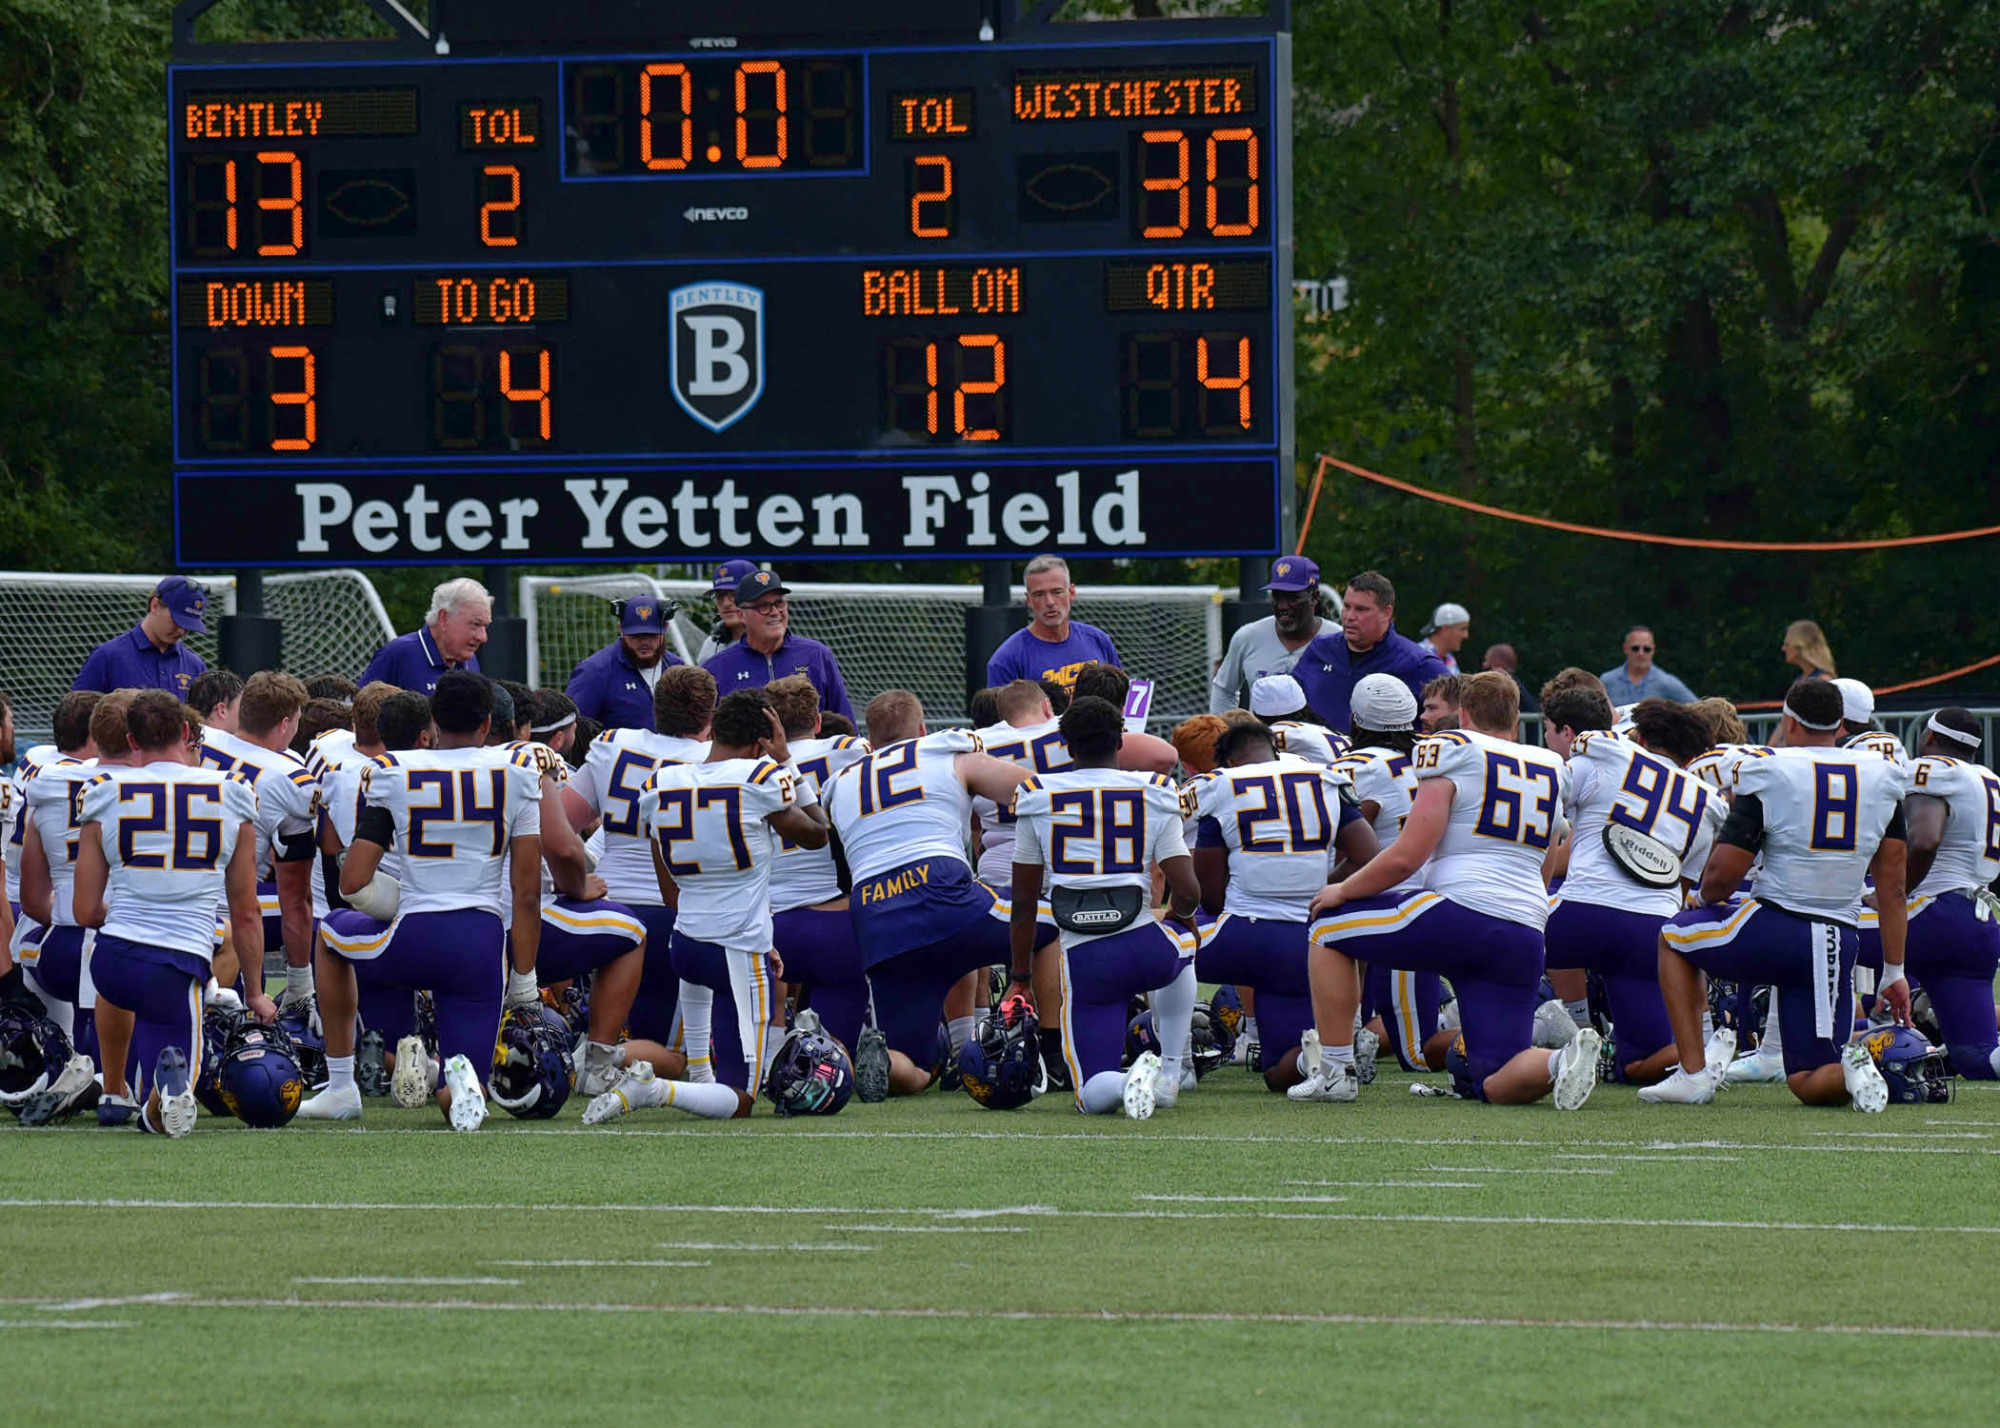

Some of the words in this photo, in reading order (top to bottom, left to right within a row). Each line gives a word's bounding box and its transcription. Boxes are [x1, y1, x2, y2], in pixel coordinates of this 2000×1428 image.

[186, 102, 323, 138] BENTLEY
[469, 109, 535, 144] TOL
[901, 98, 968, 134] TOL
[1014, 78, 1242, 119] WESTCHESTER
[225, 151, 303, 256] 13
[481, 165, 521, 246] 2
[912, 155, 952, 238] 2
[1142, 127, 1259, 238] 30
[207, 281, 305, 327] DOWN
[437, 278, 478, 323] TO
[488, 278, 536, 323] GO
[675, 288, 758, 308] BENTLEY
[863, 270, 959, 316] BALL
[971, 267, 1020, 313] ON
[1147, 263, 1215, 310] QTR
[499, 349, 551, 440] 4
[683, 315, 749, 396] B
[926, 333, 1005, 441] 12
[1197, 336, 1251, 429] 4
[270, 346, 316, 450] 3
[295, 482, 540, 553] Peter
[564, 478, 870, 550] Yetten
[902, 470, 1147, 547] Field
[1130, 684, 1148, 716] 7
[778, 774, 793, 803] 2
[1416, 744, 1441, 769] 63
[1915, 763, 1932, 787] 6
[118, 782, 223, 872] 26
[407, 767, 506, 859] 24
[656, 785, 754, 876] 27
[1050, 787, 1145, 875] 28
[1230, 771, 1332, 854] 20
[1473, 749, 1560, 850] 63
[1608, 749, 1708, 862] 94
[1809, 761, 1859, 852] 8
[861, 864, 930, 905] FAMILY
[1623, 837, 1668, 870] Riddell
[1077, 913, 1117, 921] BATTLE
